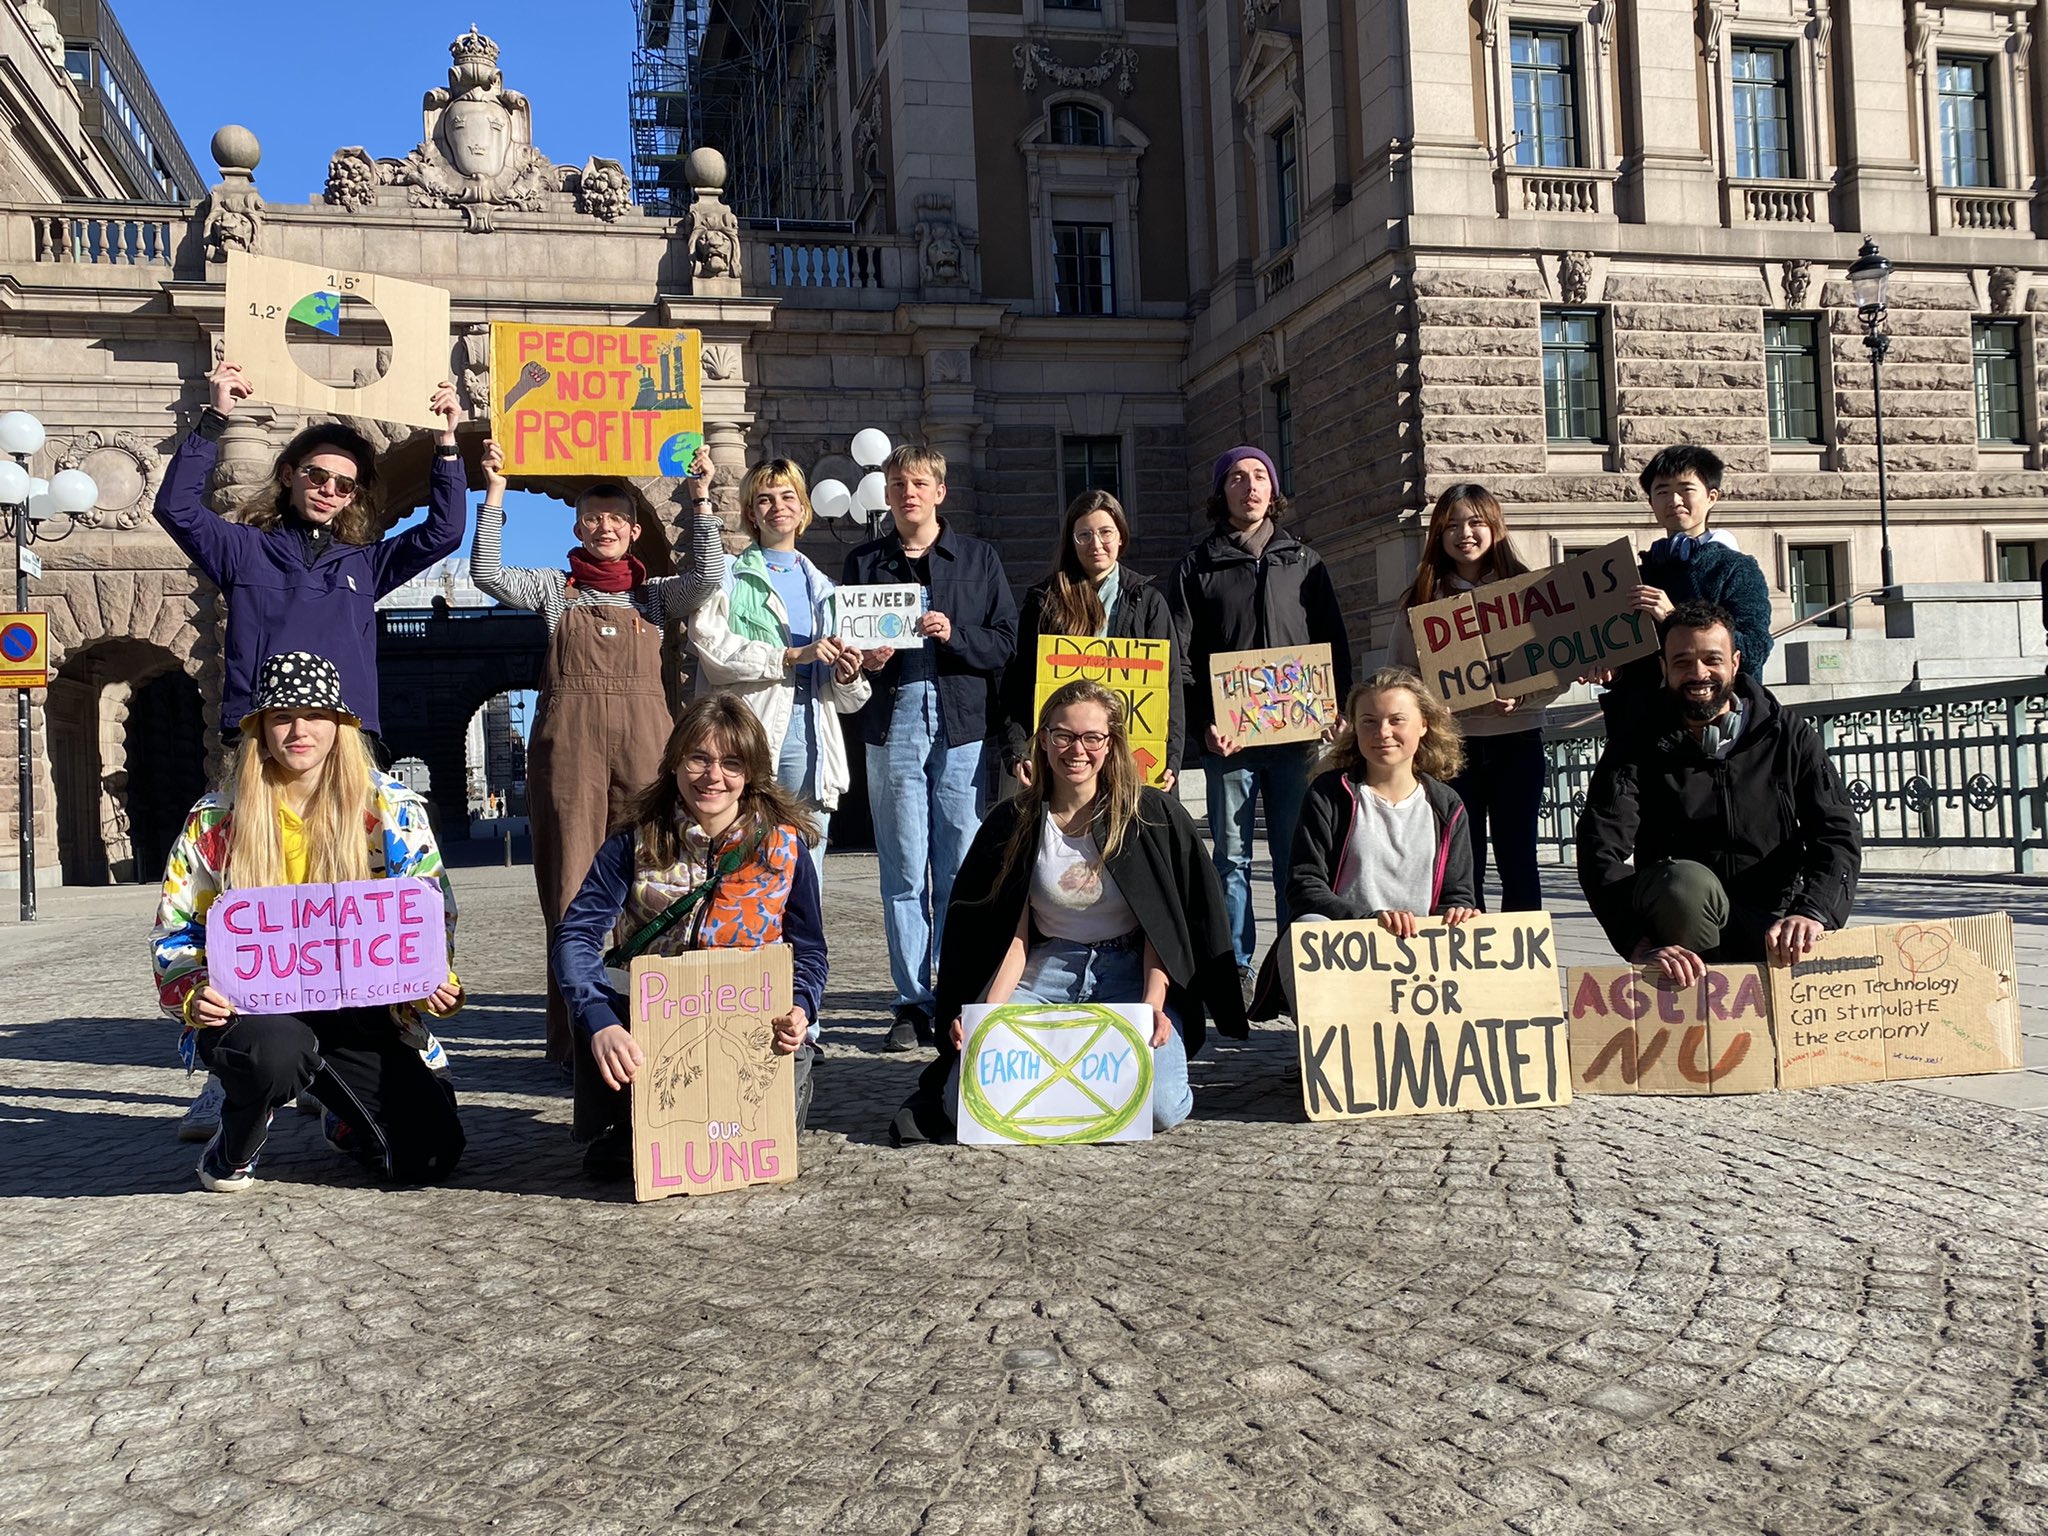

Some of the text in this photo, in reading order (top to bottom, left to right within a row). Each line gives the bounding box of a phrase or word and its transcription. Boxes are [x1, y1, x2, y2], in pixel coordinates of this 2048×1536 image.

[249, 303, 282, 319] 1,2°
[519, 331, 658, 364] PEOPLE
[557, 371, 632, 401] NOT
[515, 410, 661, 464] PROFIT
[842, 592, 916, 607] WE NEED
[1423, 559, 1617, 653] DENIAL IS
[1054, 638, 1160, 684] DON'T
[1083, 657, 1112, 666] JUST
[1438, 609, 1643, 699] NOT POLICY
[1214, 666, 1268, 698] THIS
[1237, 706, 1262, 736] A
[223, 889, 423, 934] CLIMATE
[234, 931, 420, 980] JUSTICE
[1299, 926, 1552, 974] SKOLSTREJK
[304, 988, 325, 1005] TO
[332, 985, 358, 1004] THE
[367, 981, 431, 999] SCIENCE
[640, 971, 772, 1022] Protect
[1390, 974, 1462, 1016] FÖR
[1572, 970, 1767, 1025] AGERA
[1790, 976, 1960, 1004] Green Technology
[1582, 1024, 1752, 1085] NU
[1794, 1021, 1930, 1047] the economy
[980, 1047, 1131, 1086] EARTH DAY
[1303, 1016, 1564, 1115] KLIMATET
[708, 1120, 742, 1140] OUR
[651, 1139, 779, 1187] LUNG
